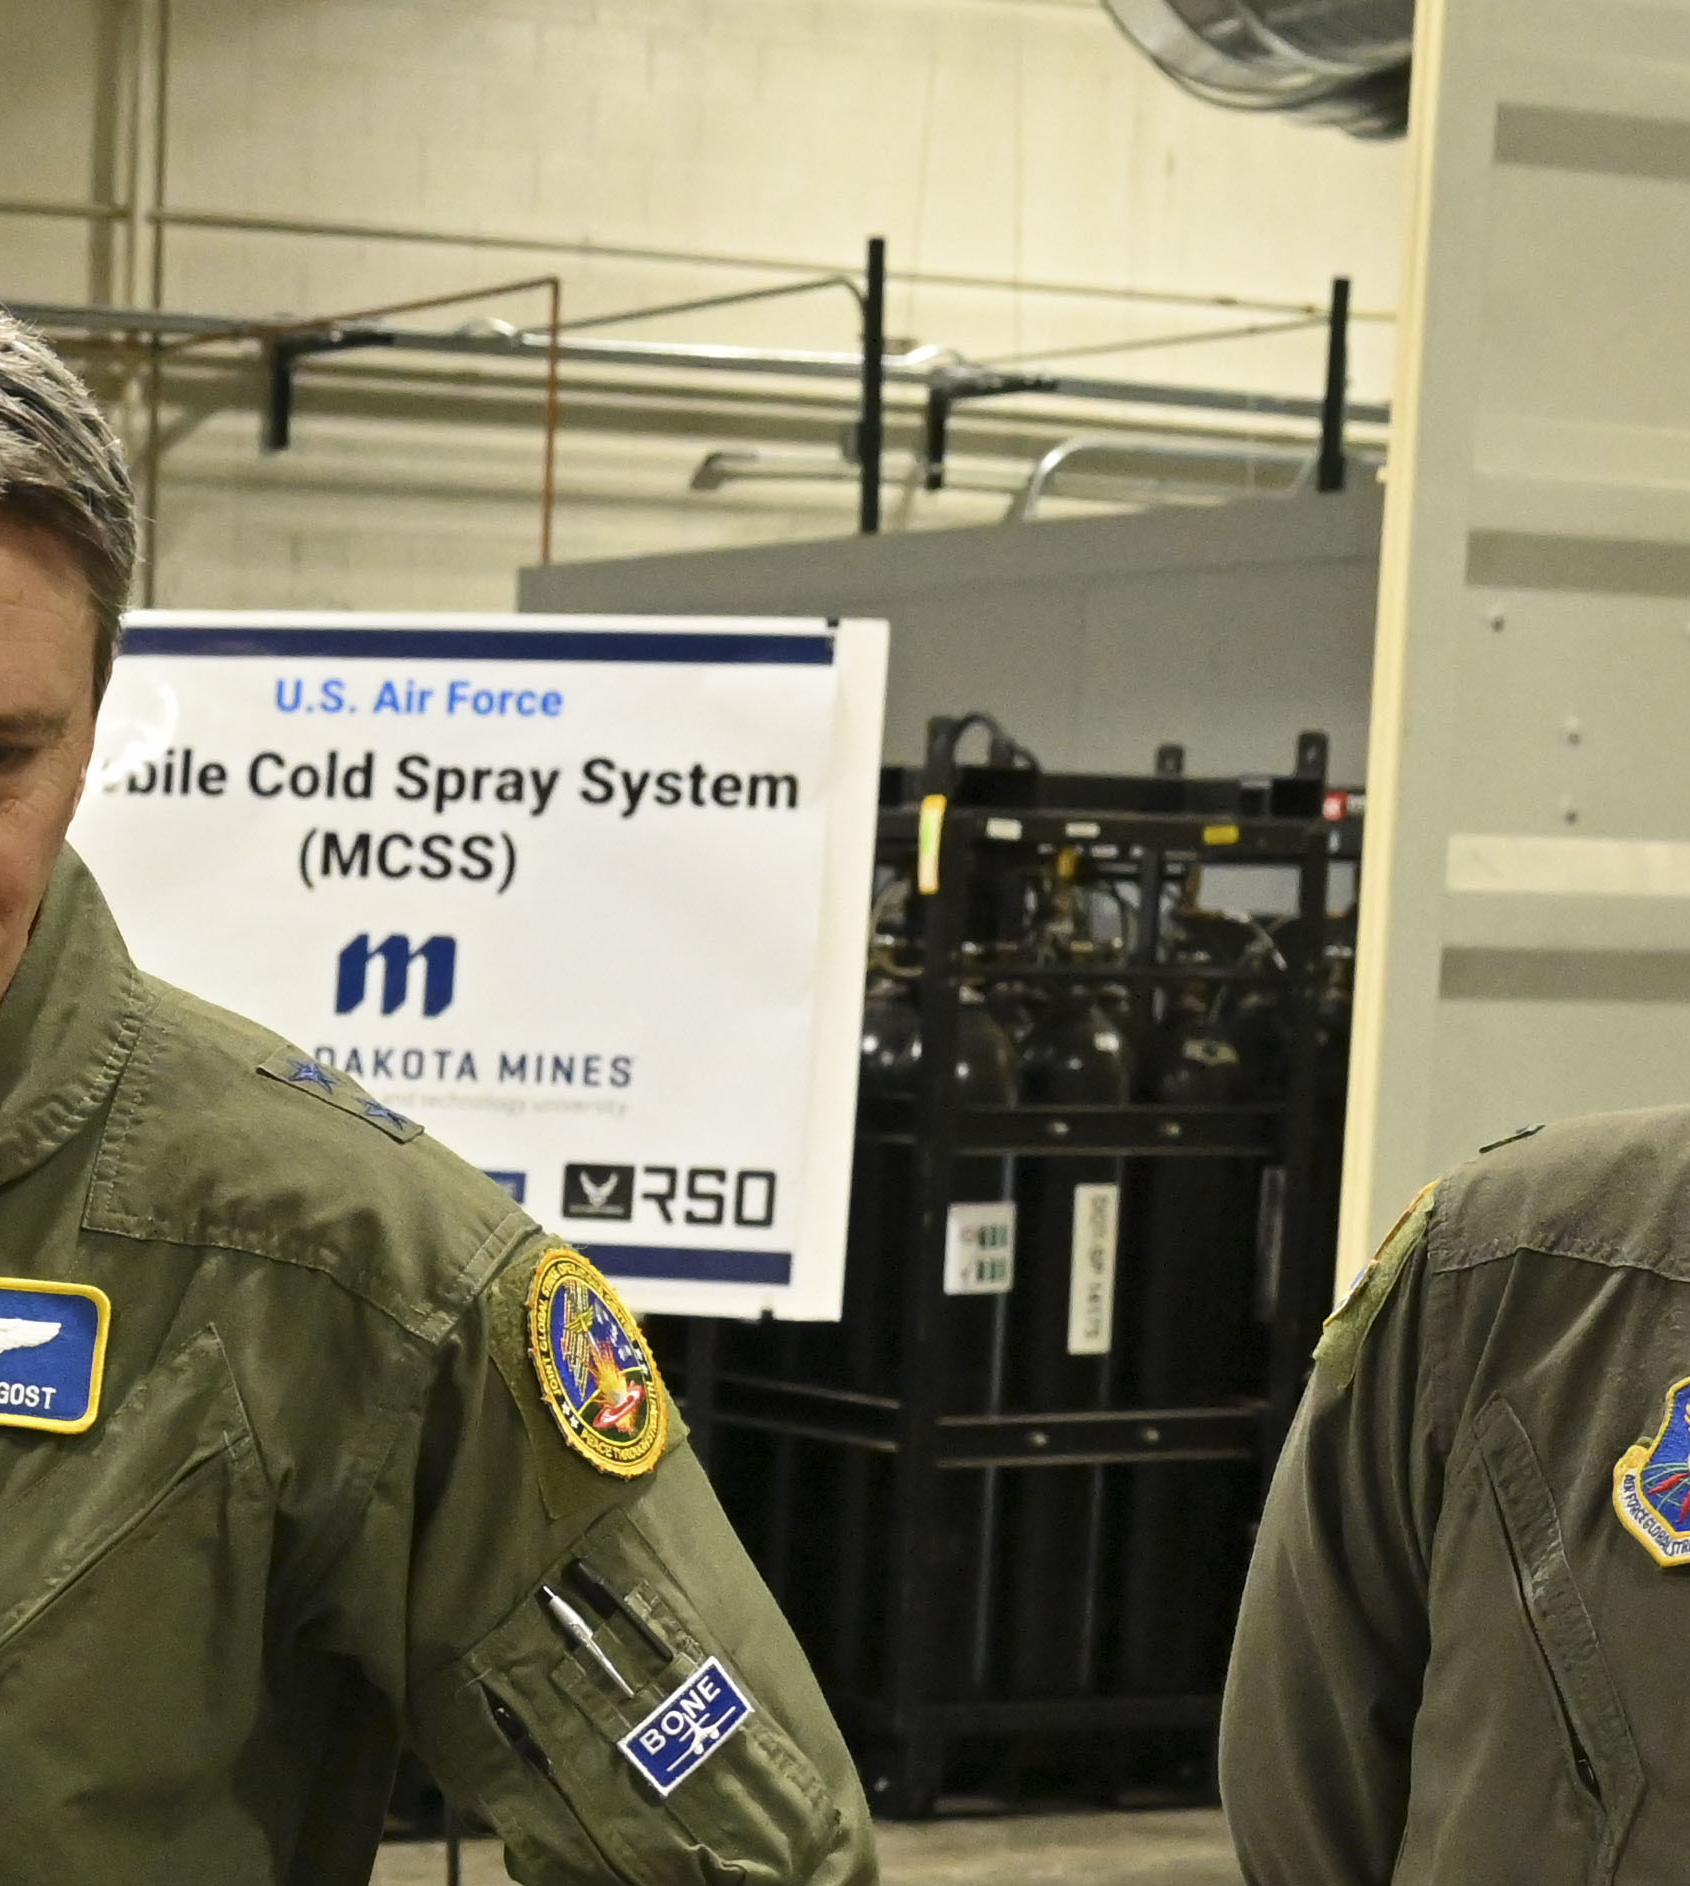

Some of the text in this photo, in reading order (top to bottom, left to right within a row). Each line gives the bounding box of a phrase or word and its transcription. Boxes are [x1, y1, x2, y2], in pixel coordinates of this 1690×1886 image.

[275, 679, 564, 717] U.S. Air Force
[101, 747, 799, 819] bile Cold Spray System
[299, 827, 517, 895] (MCSS)
[497, 1053, 635, 1089] MINES
[1624, 1492, 1648, 1525] FORCE
[639, 1674, 722, 1756] BONE
